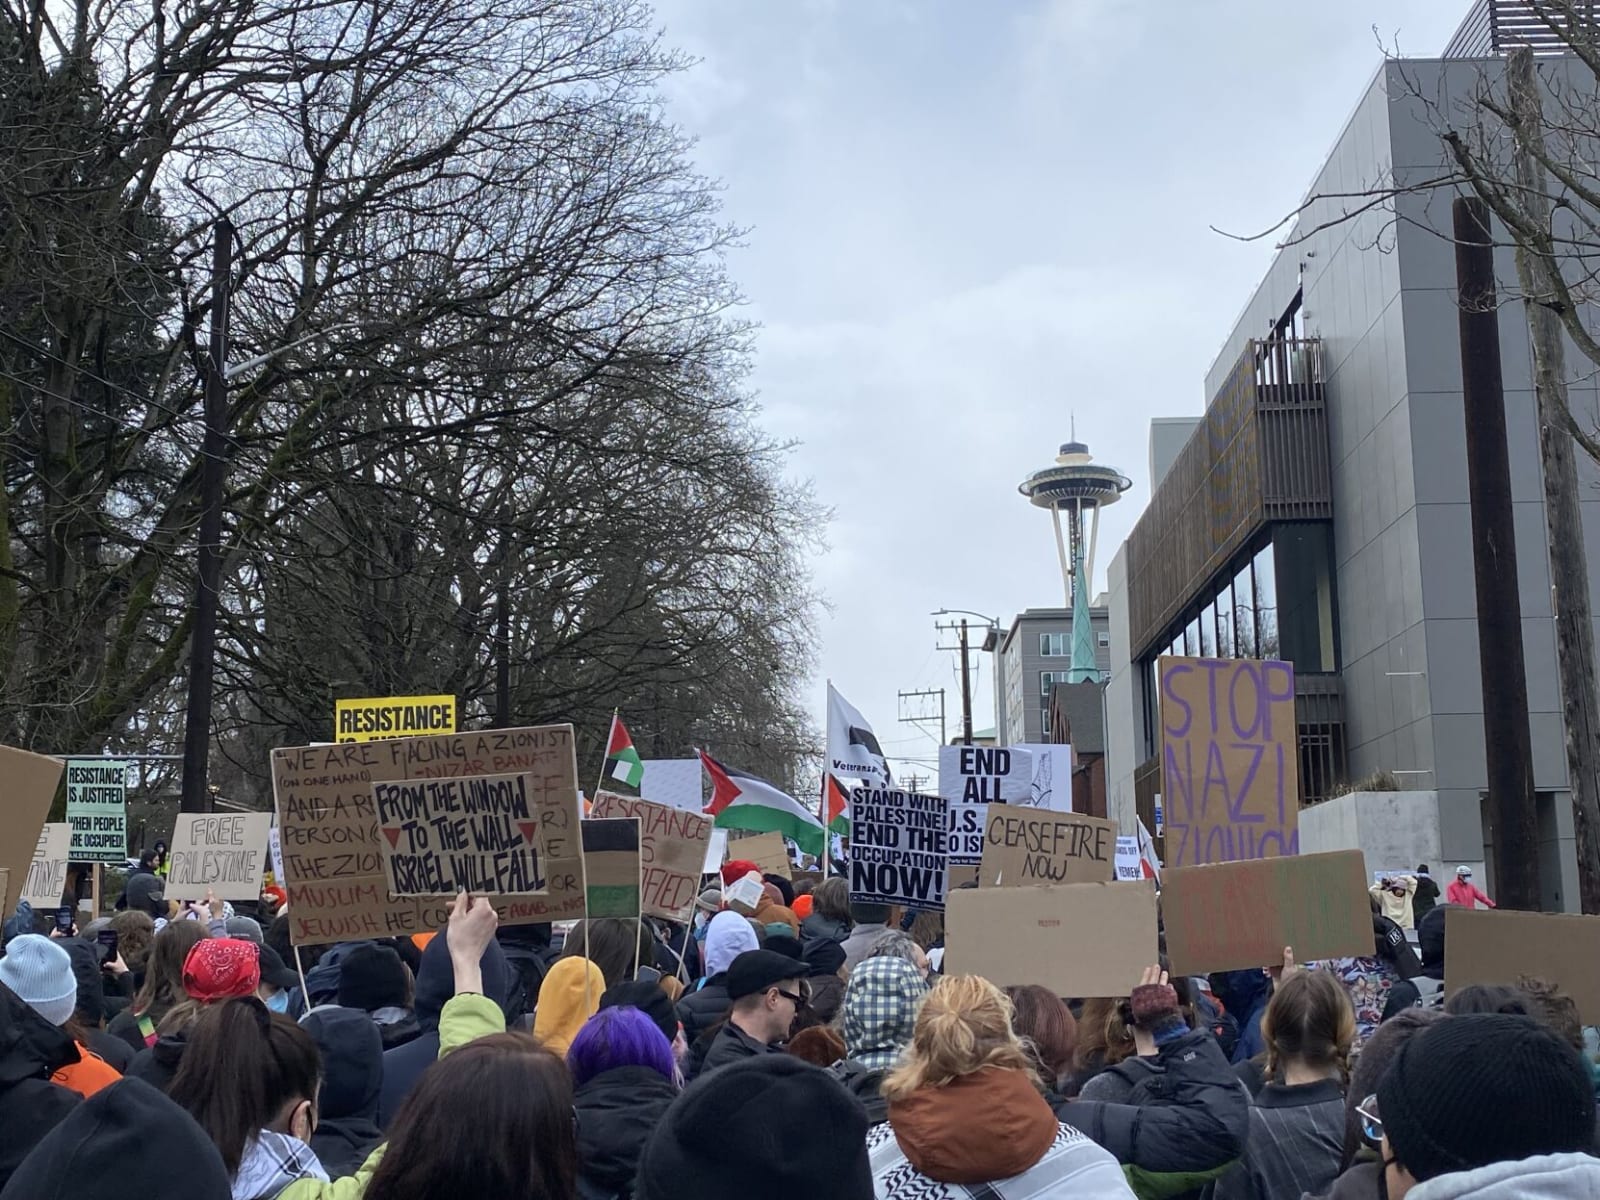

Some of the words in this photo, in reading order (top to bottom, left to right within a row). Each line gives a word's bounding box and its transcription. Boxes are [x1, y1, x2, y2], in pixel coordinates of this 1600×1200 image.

[1163, 660, 1294, 742] STOP
[340, 704, 452, 733] RESISTANCE
[324, 745, 379, 770] ARE
[390, 736, 467, 766] FACING
[475, 737, 490, 755] A
[491, 730, 571, 751] ZIONIST
[960, 747, 1011, 776] END
[69, 767, 124, 785] RESISTANCE
[303, 775, 329, 787] ONE
[333, 769, 372, 785] HAND)
[962, 776, 1007, 804] ALL
[1165, 739, 1285, 825] NAZI
[69, 786, 77, 803] IS
[80, 787, 123, 804] JUSTIFIED
[286, 794, 329, 822] AND
[375, 783, 431, 825] FROM
[427, 781, 460, 812] THE
[460, 775, 530, 819] WINDOW
[853, 787, 904, 807] STAND
[908, 793, 948, 814] WITH
[94, 817, 124, 831] PEOPLE
[190, 816, 246, 846] FREE
[853, 805, 947, 831] PALESTINE!
[84, 834, 125, 848] OCCUPIED!
[284, 825, 367, 846] PERSON
[401, 820, 428, 853] TO
[430, 815, 469, 851] THE
[470, 814, 523, 852] WALL
[853, 821, 899, 848] END
[905, 827, 947, 854] THE
[988, 816, 1110, 862] CEASEFIRE
[168, 850, 257, 885] PALESTINE
[285, 854, 329, 879] THE
[390, 850, 453, 894] ISRAEL
[450, 853, 495, 893] WILL
[493, 848, 546, 894] FALL
[852, 845, 946, 871] OCCUPATION
[1022, 853, 1067, 882] NOW
[552, 874, 578, 891] OR
[852, 861, 943, 902] NOW!
[288, 885, 379, 909] MUSLIM
[296, 912, 378, 940] JEWISH
[385, 911, 415, 931] HE
